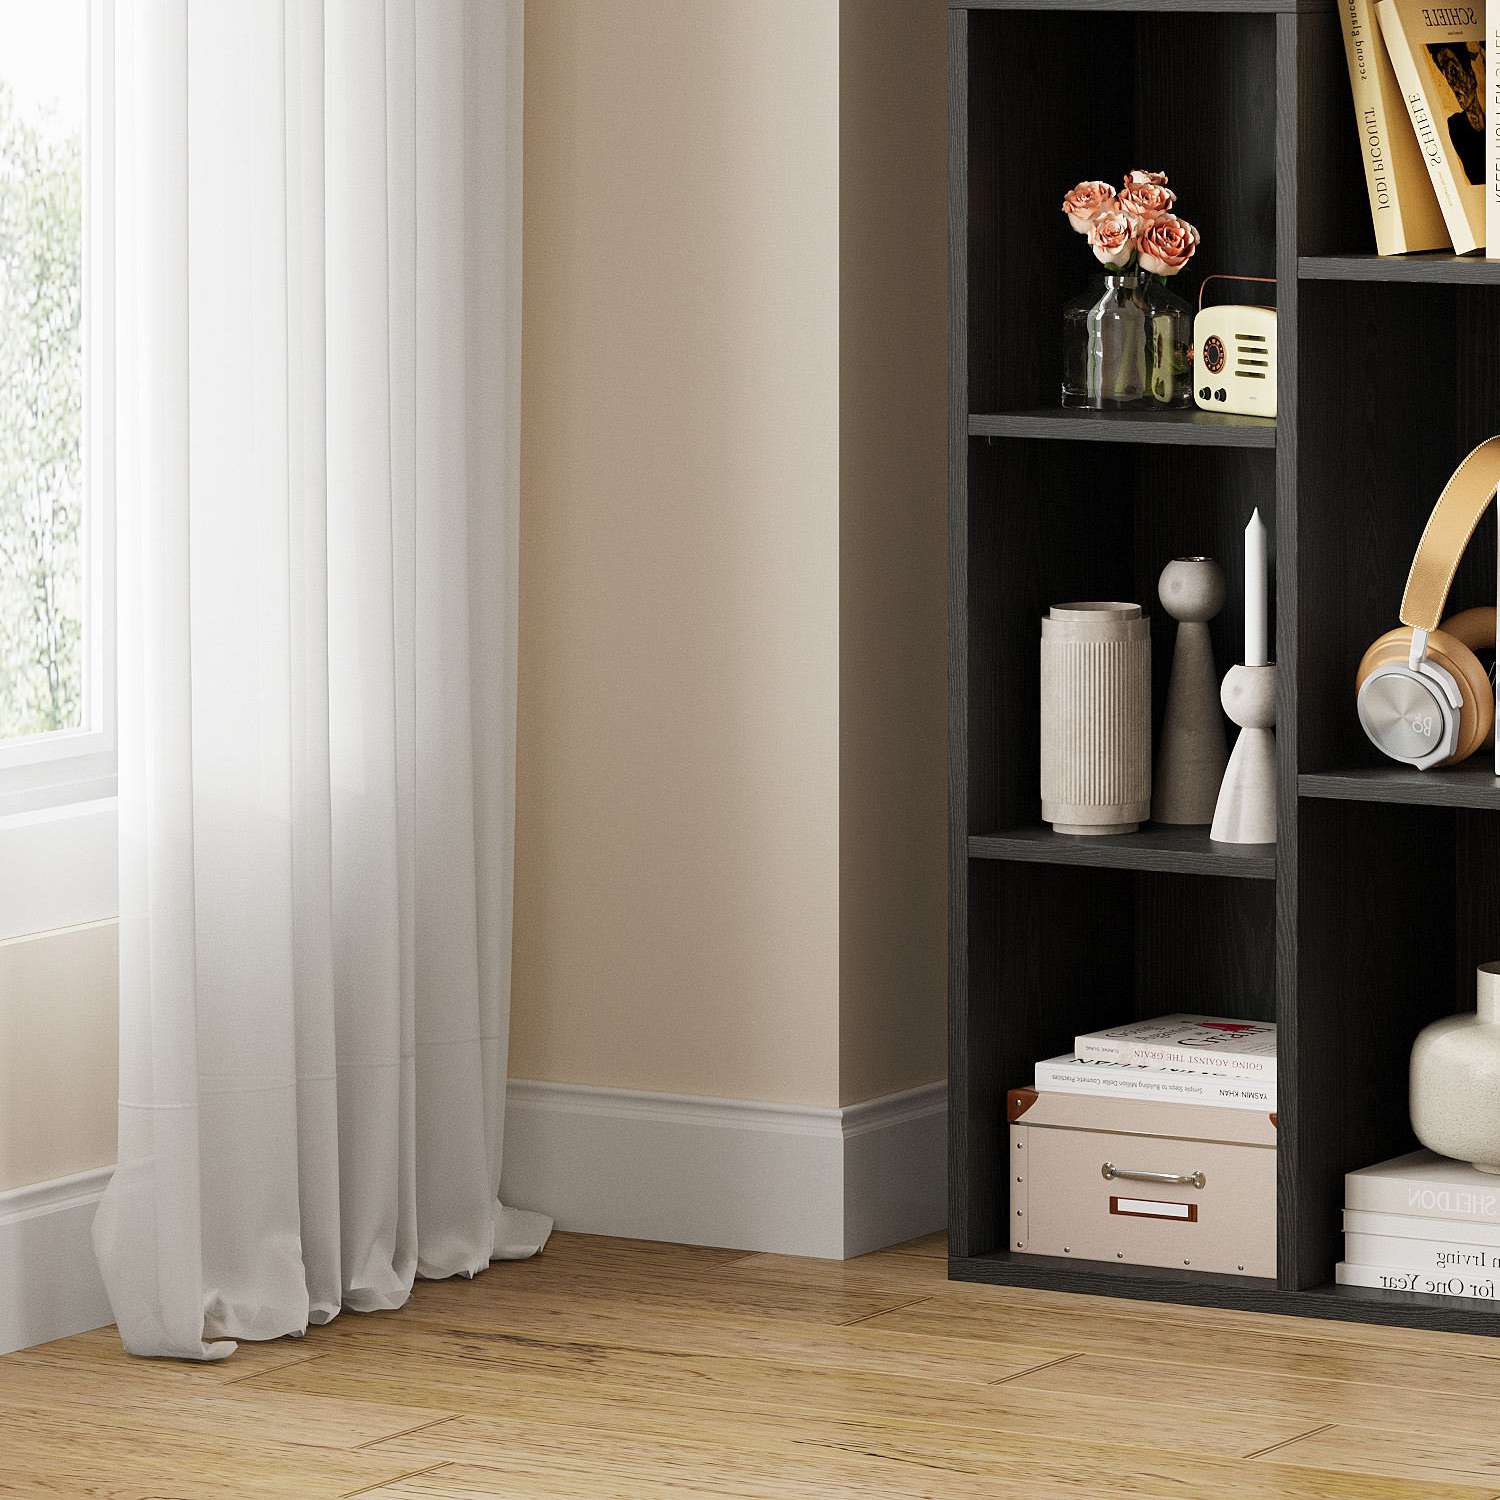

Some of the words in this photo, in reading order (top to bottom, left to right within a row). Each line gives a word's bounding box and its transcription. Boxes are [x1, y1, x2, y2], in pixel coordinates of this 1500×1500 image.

[1133, 1049, 1164, 1061] GRAIN
[1166, 1053, 1185, 1063] THE
[1187, 1055, 1229, 1068] AGAINST
[1232, 1061, 1263, 1072] GOING
[1051, 1074, 1075, 1084] Practices
[1076, 1076, 1101, 1086] Cosmetic
[1101, 1079, 1118, 1087] Dollar
[1118, 1080, 1138, 1089] Million
[1138, 1081, 1161, 1092] Building
[1161, 1084, 1168, 1092] to
[1168, 1084, 1184, 1093] Steps
[1184, 1085, 1203, 1095] Simple
[1218, 1089, 1239, 1099] KHAN
[1240, 1091, 1268, 1101] YASMIN
